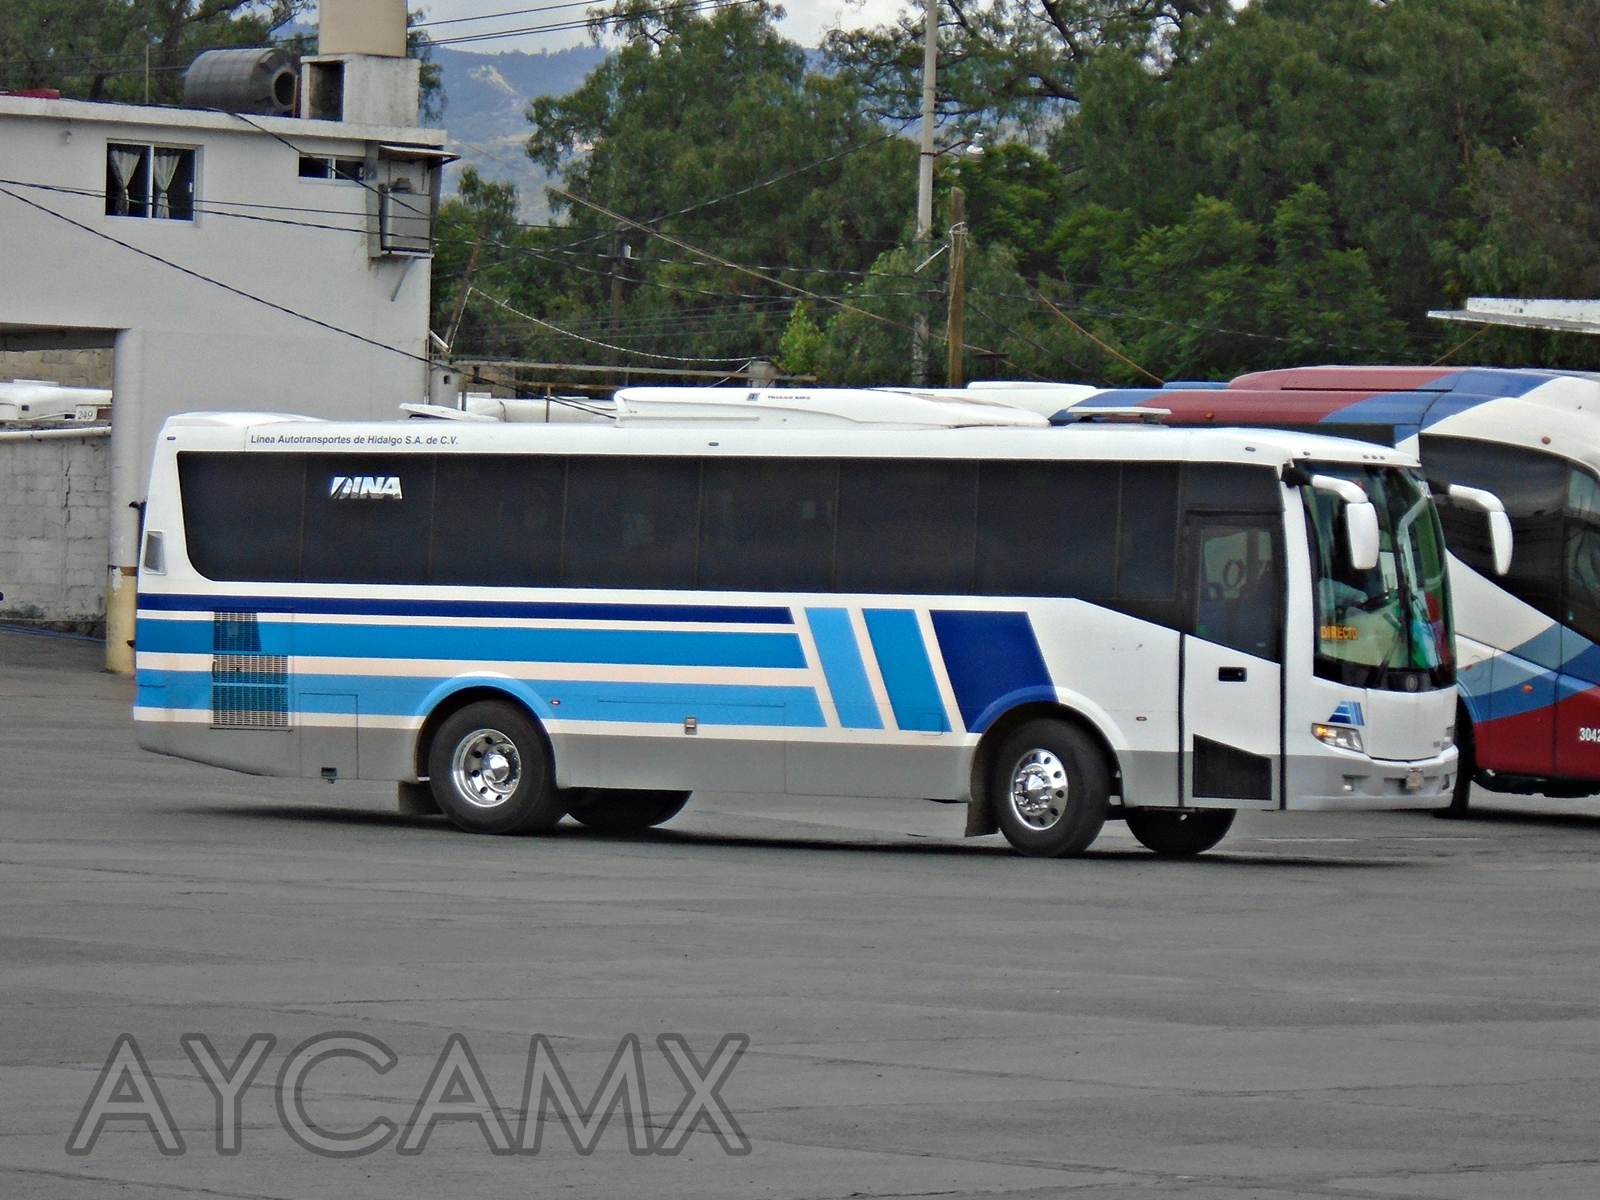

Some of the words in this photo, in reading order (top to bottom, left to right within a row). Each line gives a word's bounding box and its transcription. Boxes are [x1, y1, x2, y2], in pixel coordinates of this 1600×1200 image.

[78, 410, 94, 419] 249
[277, 435, 351, 446] Autotransportes
[353, 435, 366, 444] de
[367, 435, 403, 446] Hidalgo
[404, 436, 423, 445] S.A.
[426, 436, 438, 445] de
[440, 436, 459, 445] C.V.
[330, 476, 403, 500] DINA
[1320, 625, 1358, 640] DIRECTO
